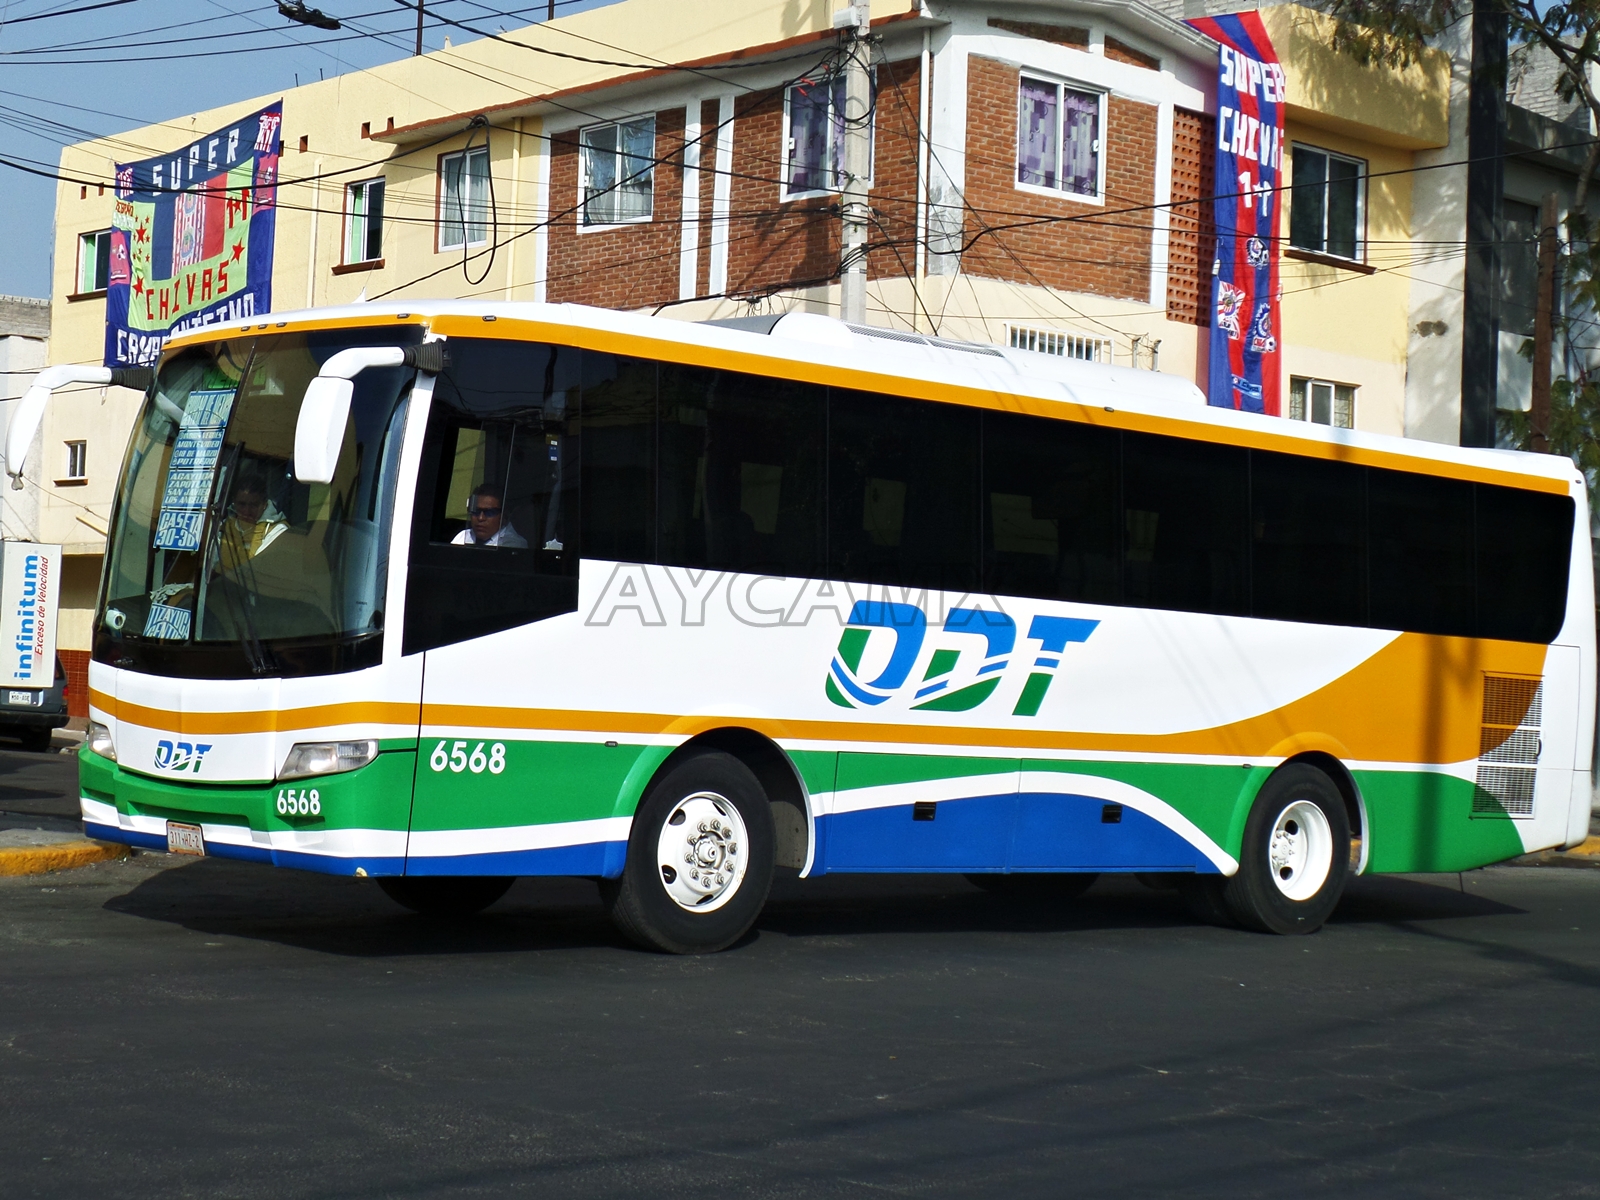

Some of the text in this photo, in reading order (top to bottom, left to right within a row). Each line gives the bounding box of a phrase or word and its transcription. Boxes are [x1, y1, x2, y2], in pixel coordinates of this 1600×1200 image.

[1221, 44, 1285, 103] SUPER
[152, 128, 239, 196] SUPER
[145, 259, 229, 321] CHIVAS
[159, 512, 203, 544] CASETA
[14, 555, 38, 679] infinitum
[34, 556, 49, 655] Exceso de Velocidad
[825, 600, 1101, 716] ODT
[154, 739, 213, 773] ODT
[430, 740, 506, 774] 6568
[277, 789, 321, 815] 6568
